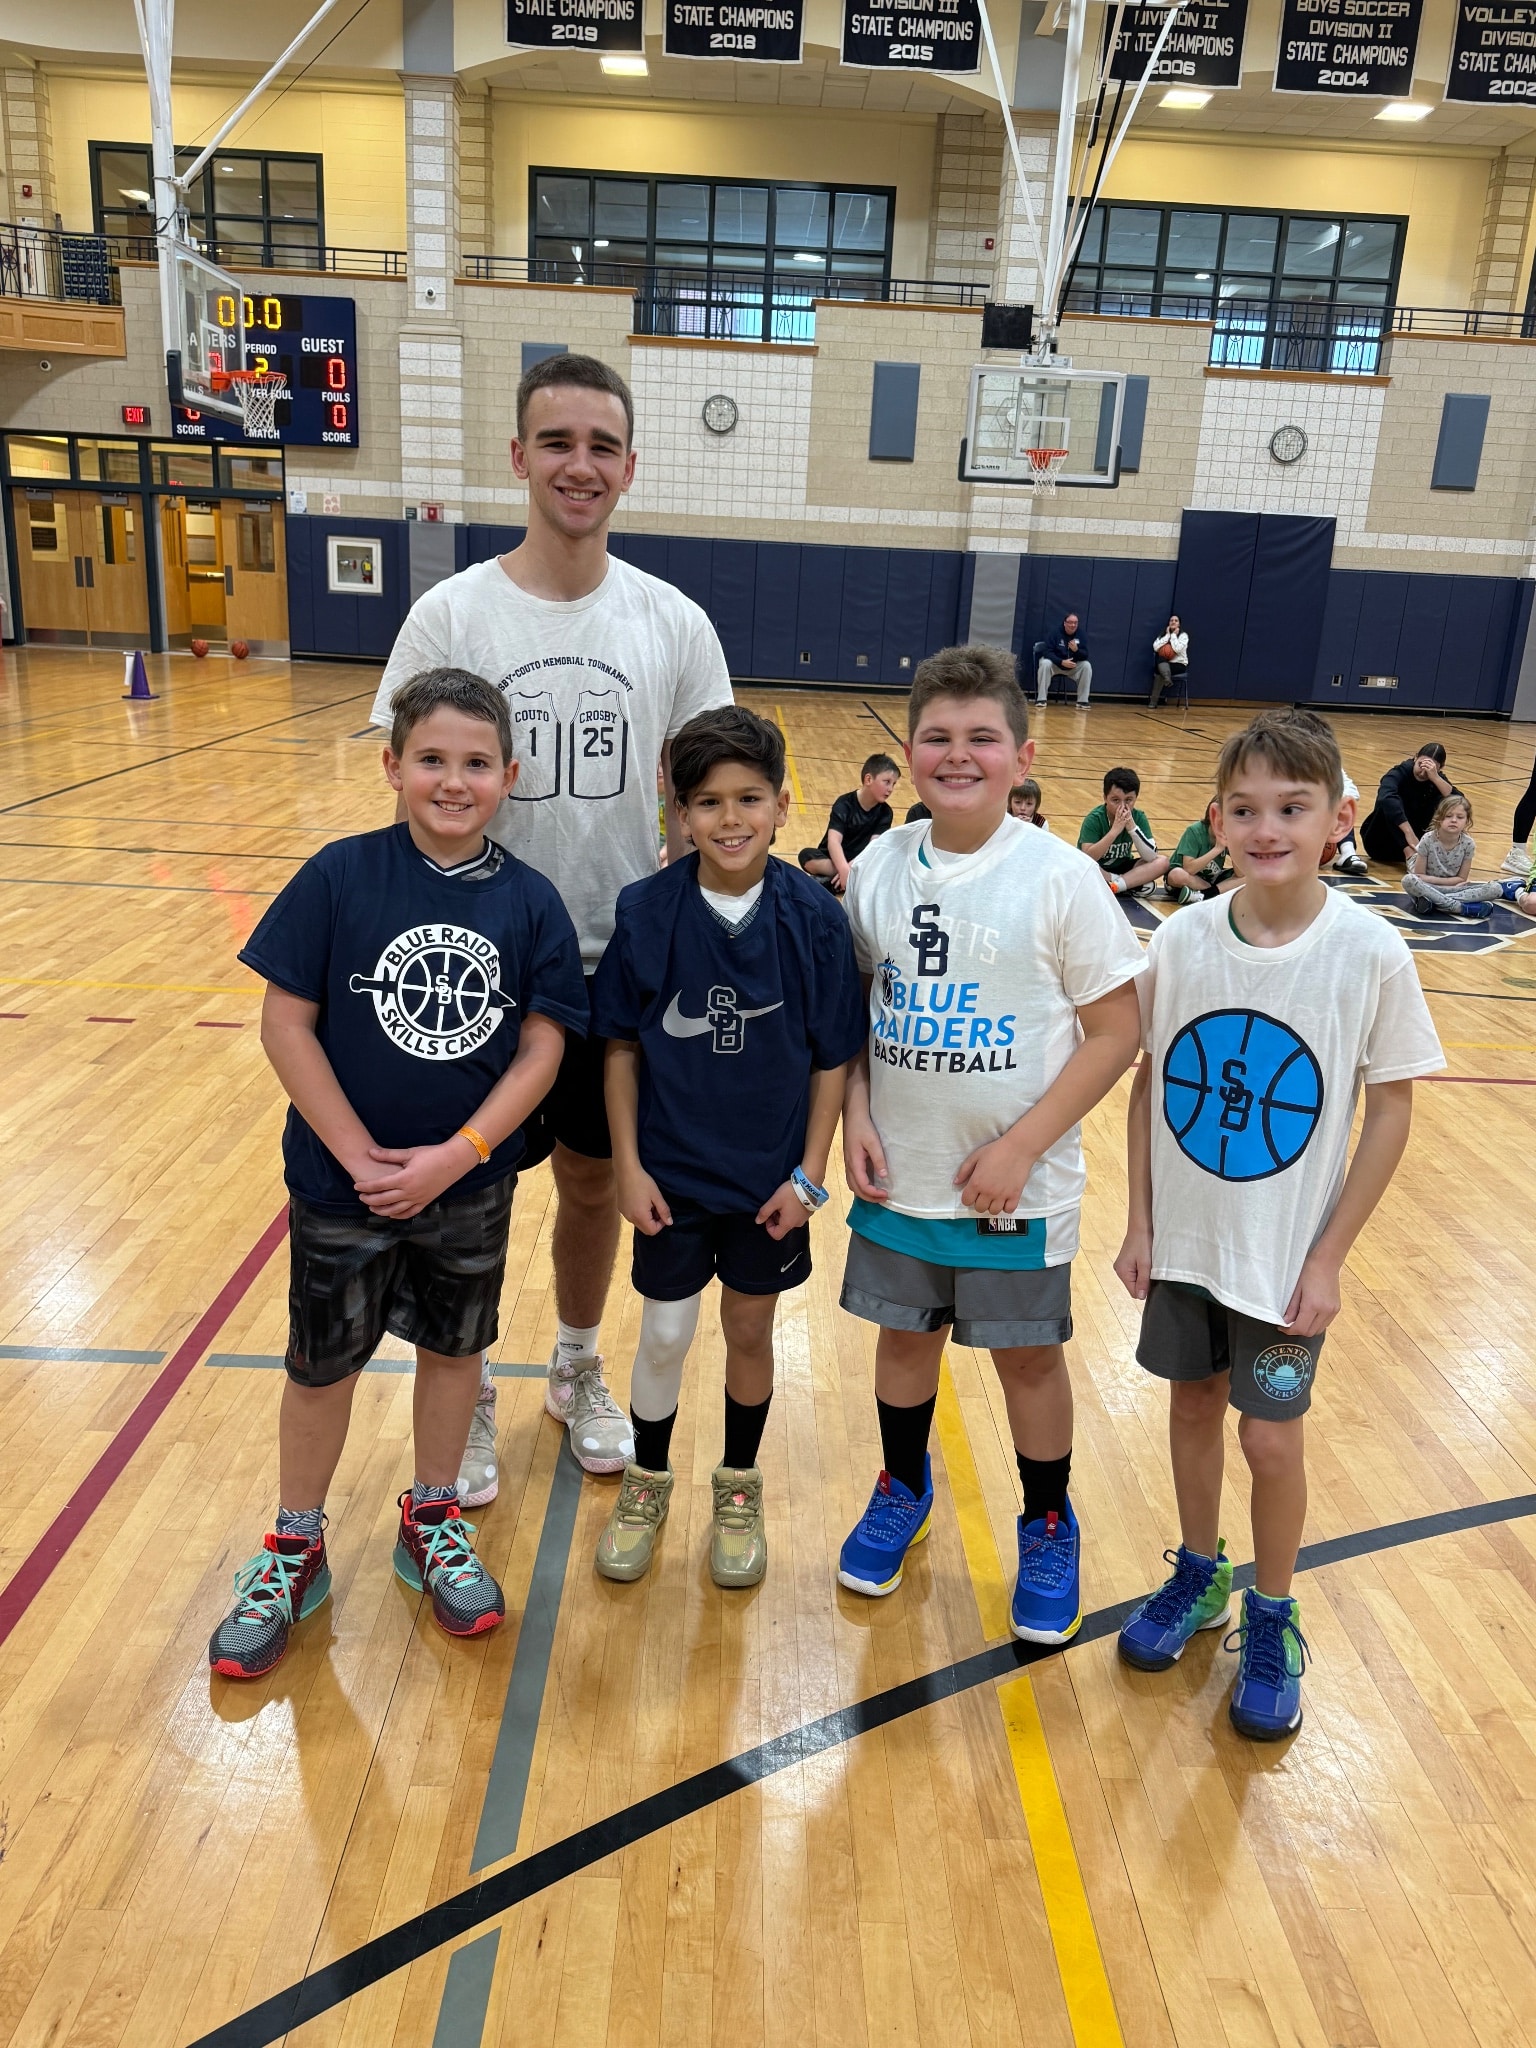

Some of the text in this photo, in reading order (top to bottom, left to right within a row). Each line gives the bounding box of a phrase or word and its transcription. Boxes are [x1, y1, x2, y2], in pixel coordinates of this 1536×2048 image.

[515, 0, 635, 20] STATE CHAMPIONS
[937, 0, 959, 14] III
[1297, 0, 1411, 17] BOYS SOCCER
[674, 4, 794, 30] STATE CHAMPIONS
[1203, 14, 1219, 29] II
[551, 24, 598, 42] 2019
[851, 14, 974, 40] STATE CHAMPIONS
[1309, 20, 1394, 39] DIVISION II
[709, 33, 756, 49] 2018
[1115, 31, 1156, 53] STTE
[888, 44, 934, 61] 2015
[1286, 41, 1409, 66] STATE CHAMPIONS
[1459, 51, 1501, 72] STATE
[1318, 70, 1369, 87] 2004
[1489, 80, 1536, 96] 2002
[245, 343, 277, 355] PERIOD
[301, 337, 345, 354] GUEST
[328, 358, 346, 389] 0
[321, 391, 351, 403] FOULS
[126, 407, 144, 423] EXIT
[333, 404, 347, 428] 0
[176, 424, 206, 436] SCORE
[249, 429, 281, 440] MATCH
[322, 431, 351, 443] SCORE
[542, 656, 585, 668] MEMORIAL
[587, 658, 633, 693] TOURNAMENT
[515, 709, 550, 723] COUTO
[579, 710, 617, 724] CROSBY
[529, 726, 537, 757] 1
[582, 727, 614, 757] 25
[385, 928, 436, 967] BLUE
[893, 982, 980, 1013] BLUE
[382, 1008, 493, 1056] SKILLS CAMP
[873, 1009, 1017, 1048] RAIDERS
[874, 1038, 1017, 1073] BASKETBALL
[997, 1217, 1018, 1232] NBA
